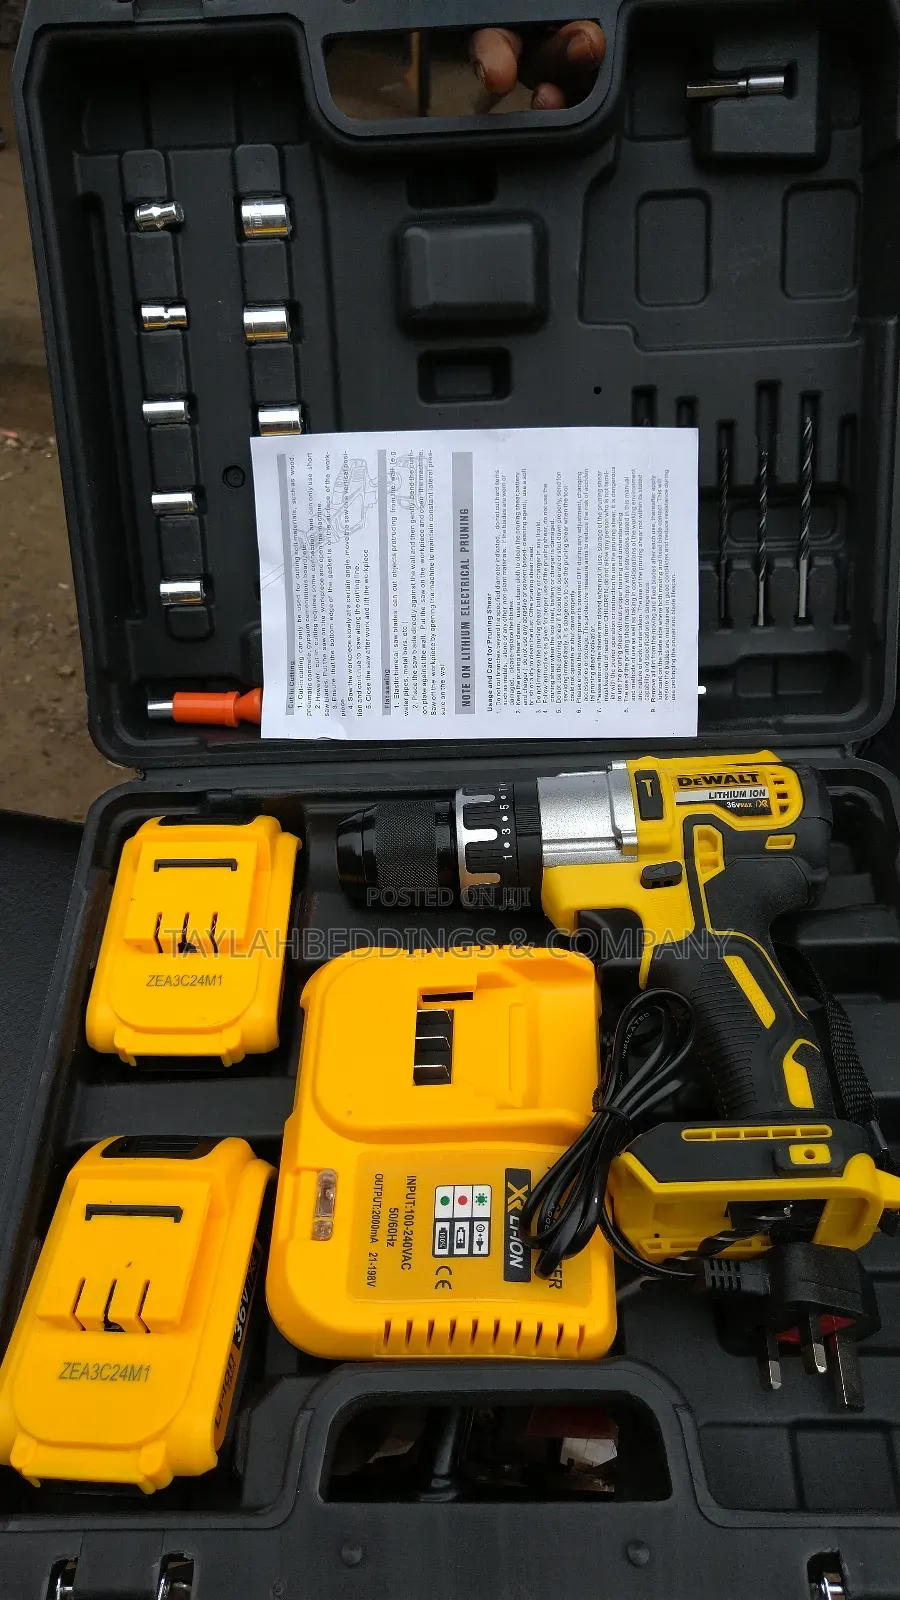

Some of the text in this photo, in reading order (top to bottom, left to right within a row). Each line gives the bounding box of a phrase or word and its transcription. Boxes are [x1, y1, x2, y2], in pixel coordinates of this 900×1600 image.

[459, 508, 471, 707] NOTE ON LITHIUM ELECTRICAL PRUNING
[486, 615, 494, 644] Pruning
[486, 690, 494, 712] Usage
[708, 789, 766, 800] LITHIUM ION
[146, 974, 223, 987] ZEA3C24M1
[369, 1173, 384, 1244] OUTPUT:2000mA
[401, 1175, 417, 1271] INPUT:100-240VAC
[386, 1207, 399, 1248] 50/60Hz
[508, 1215, 524, 1269] LI-ION
[58, 1361, 151, 1382] ZEA3C24M1
